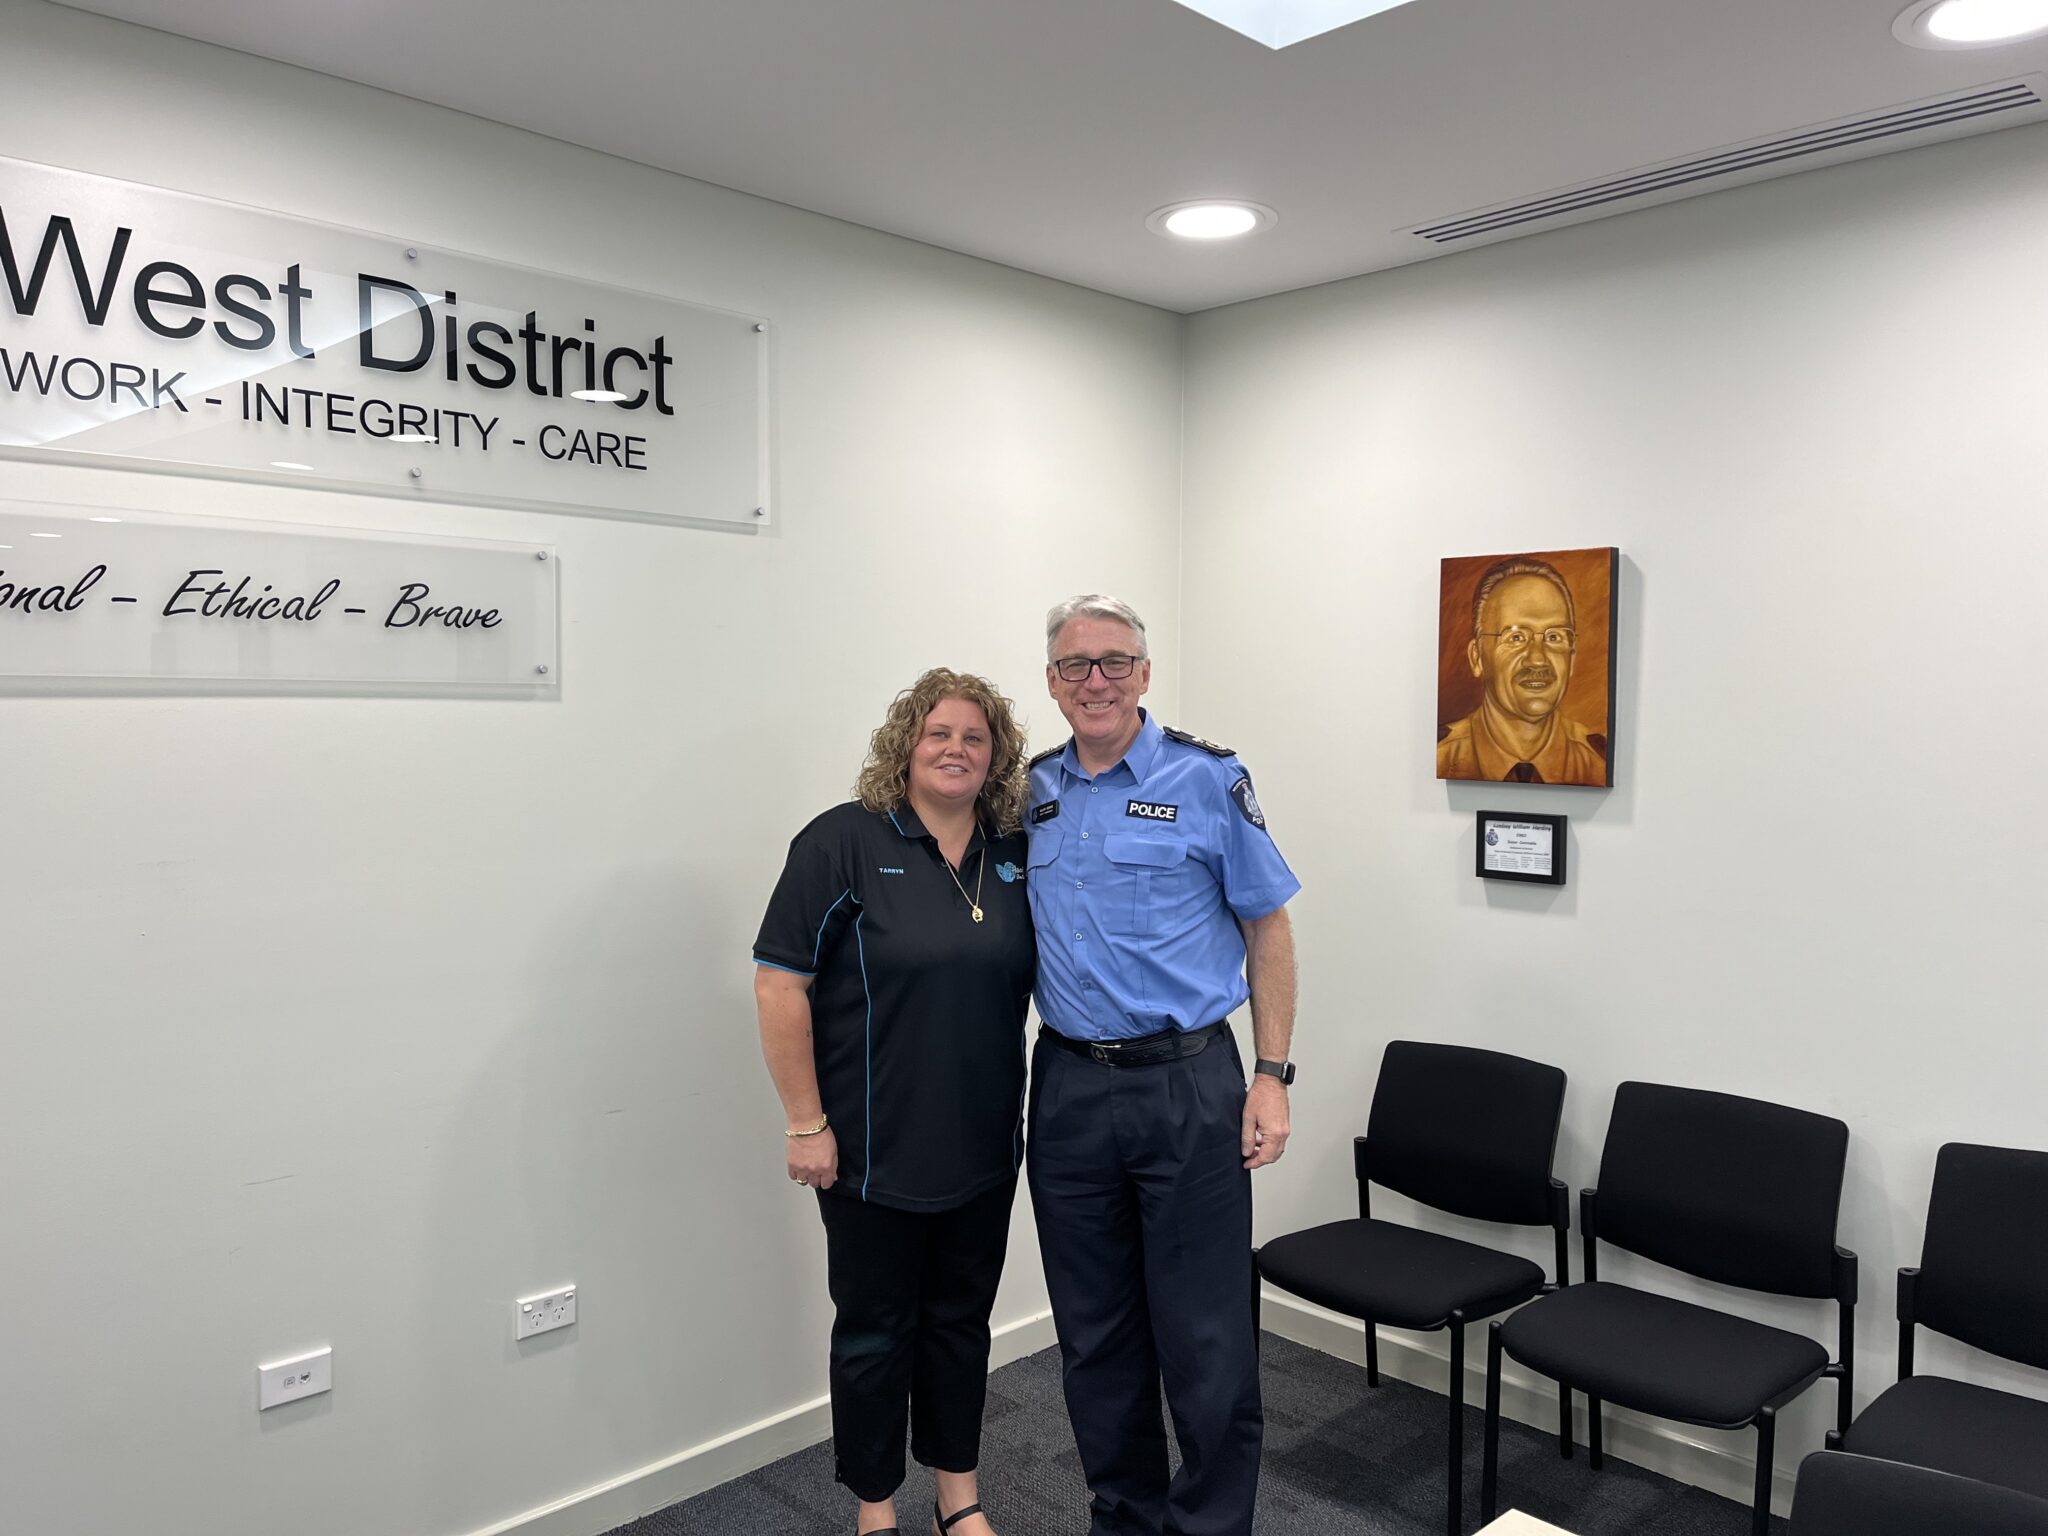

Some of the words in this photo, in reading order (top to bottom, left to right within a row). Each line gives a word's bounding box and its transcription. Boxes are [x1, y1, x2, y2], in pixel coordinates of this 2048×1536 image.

[0, 206, 315, 360] West
[357, 272, 675, 416] District
[0, 348, 190, 413] WORK
[242, 380, 500, 451] INTEGRITY
[538, 424, 648, 471] CARE
[0, 564, 108, 614] onal
[161, 569, 341, 622] Ethical
[383, 582, 503, 629] Brave
[1129, 802, 1177, 819] POLICE
[878, 867, 904, 875] TARRYN
